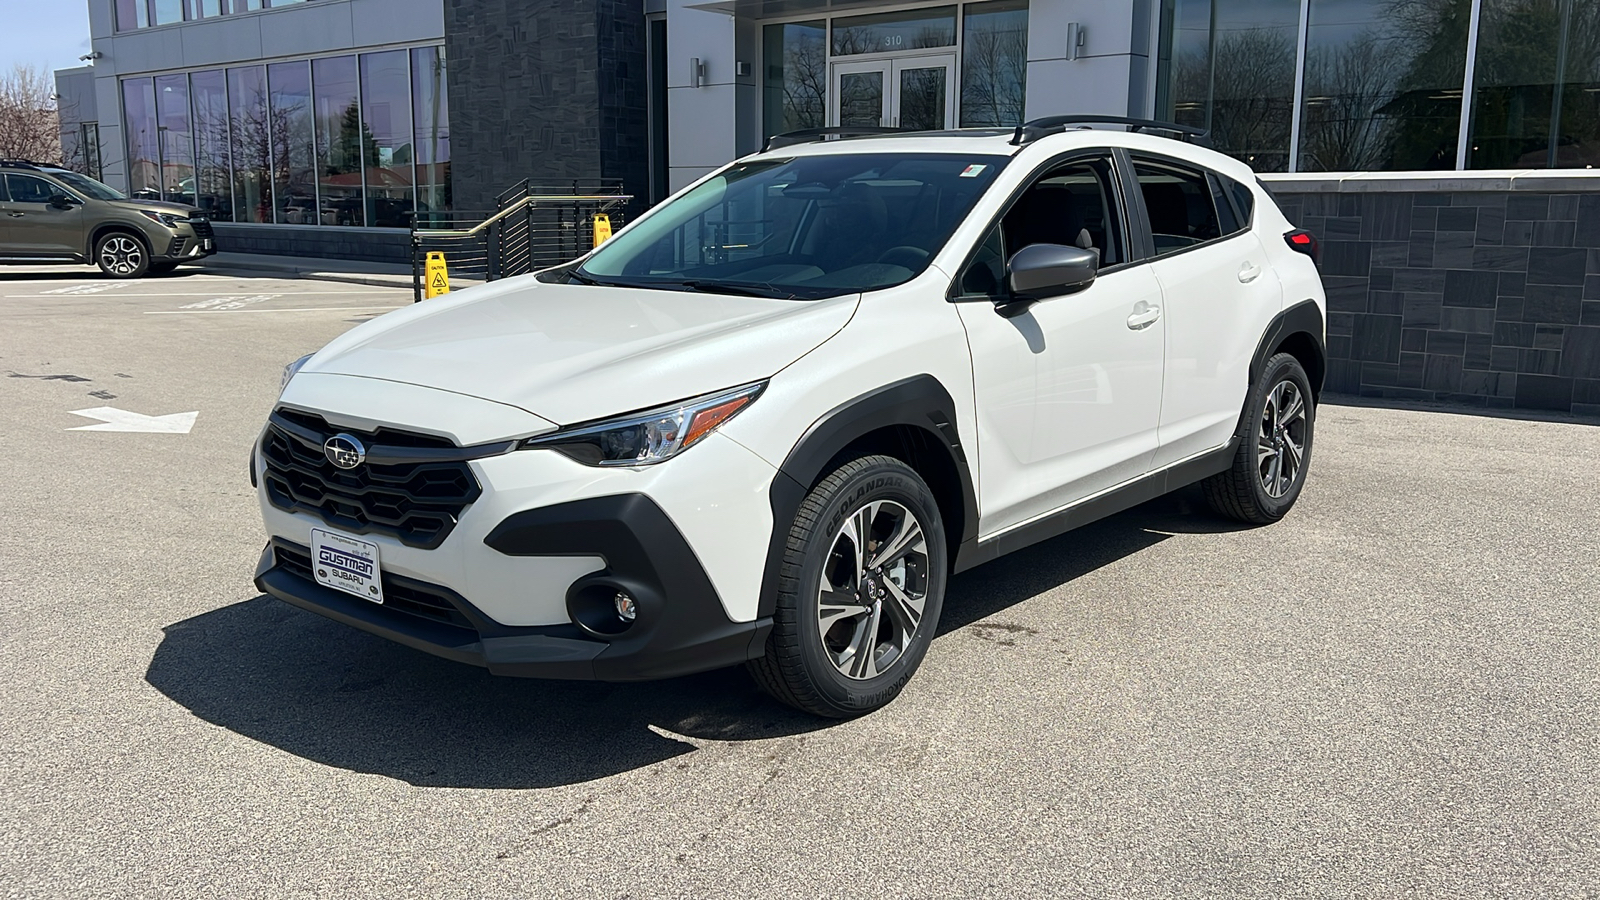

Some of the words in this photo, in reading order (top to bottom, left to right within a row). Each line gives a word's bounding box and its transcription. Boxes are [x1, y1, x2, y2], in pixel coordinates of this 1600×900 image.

[884, 35, 902, 46] 310
[825, 476, 903, 538] GEOLANDAR
[331, 568, 364, 585] SUBARU
[860, 672, 909, 707] YOKOHAMA
